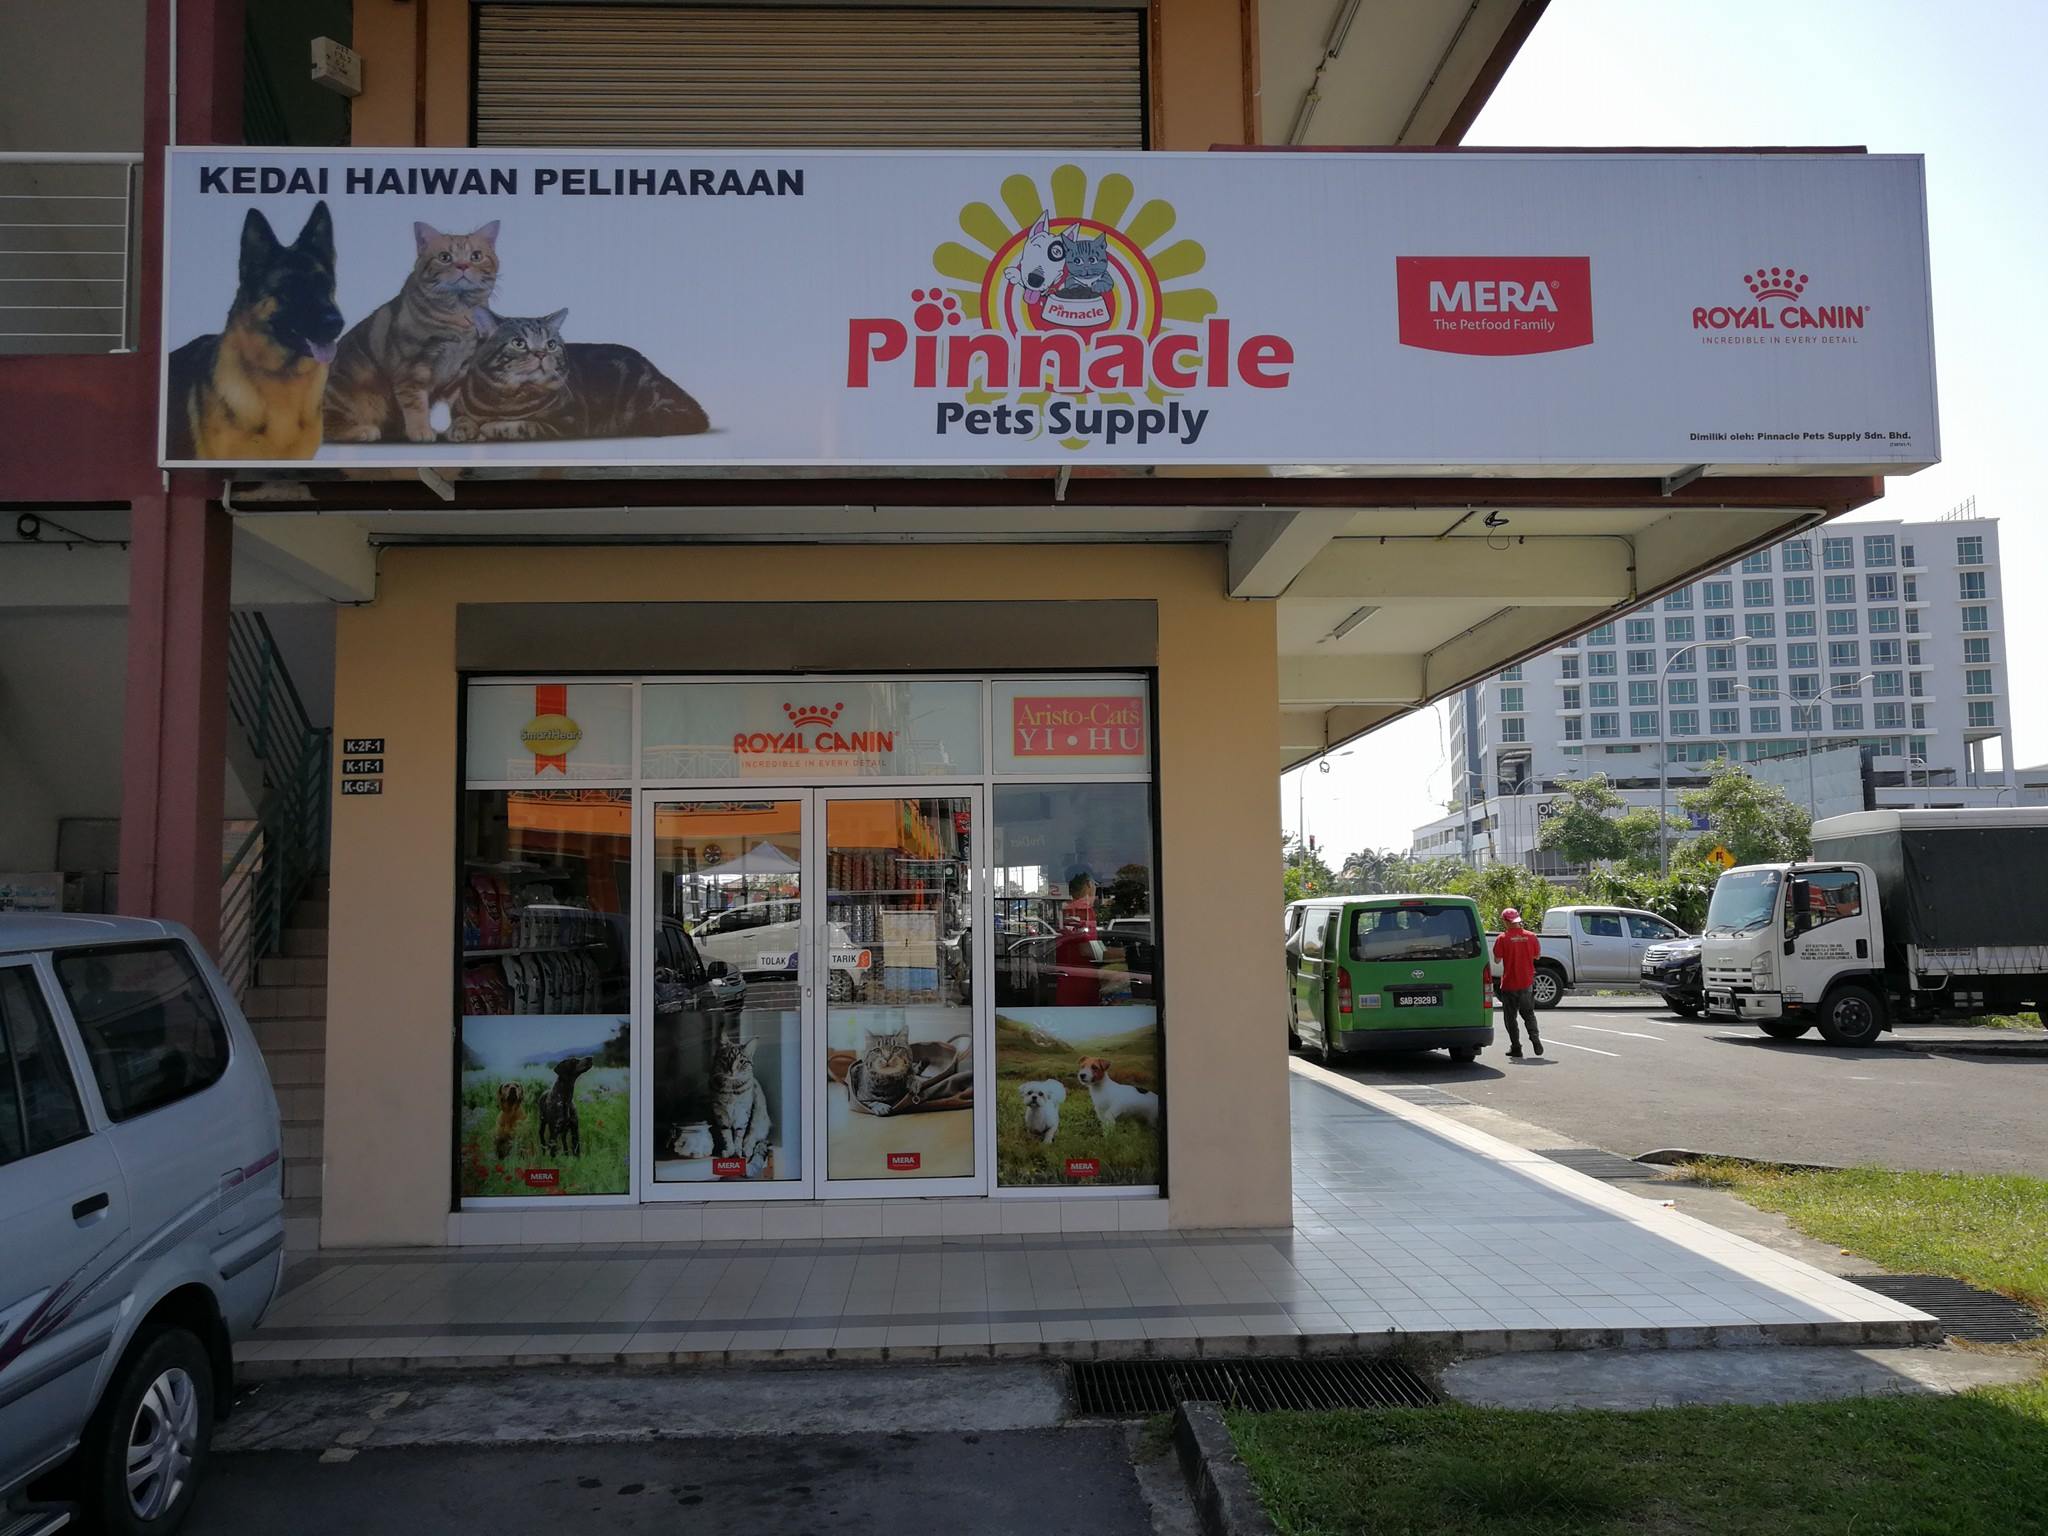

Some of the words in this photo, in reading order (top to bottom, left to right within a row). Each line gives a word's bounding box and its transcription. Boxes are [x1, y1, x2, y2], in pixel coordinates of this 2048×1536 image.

[200, 166, 329, 195] KEDAI
[346, 168, 518, 196] HAIWAN
[534, 169, 805, 197] PELIHARAAN
[1048, 304, 1104, 319] Pinnacle
[1692, 306, 1775, 329] ROYAL
[1780, 306, 1864, 329] CANIN
[1433, 319, 1457, 330] The
[1460, 319, 1511, 330] Petfood
[1514, 319, 1555, 333] Family
[1702, 336, 1766, 345] INCREDIBLE
[1770, 336, 1781, 344] IN
[1785, 336, 1818, 344] EVERY
[1821, 336, 1859, 344] DETAIL
[846, 318, 1295, 388] Pinnacle
[936, 402, 1034, 434] Pets
[1048, 401, 1209, 444] Supply
[1689, 432, 1727, 441] Dimiliki
[1729, 433, 1755, 441] oleh:
[1757, 432, 1800, 441] Pinnacle
[1802, 432, 1825, 440] Pets
[1827, 431, 1862, 442] Supply
[1864, 431, 1886, 440] Sdn.
[1888, 431, 1911, 440] Bhd.
[1018, 702, 1140, 726] Aristo-Cats
[520, 728, 584, 742] SmartHeart
[346, 740, 381, 752] K-2F-1
[734, 732, 811, 754] ROYAL
[815, 731, 894, 753] CANIN
[345, 760, 381, 772] K-1F-1
[741, 760, 801, 769] INCREDIBLE
[804, 760, 816, 768] IN
[818, 760, 849, 768] EVERY
[852, 759, 887, 767] DETAIL
[343, 781, 380, 793] K-GF-1
[760, 956, 786, 966] TOLAK
[832, 955, 857, 963] TARIK
[1399, 996, 1413, 1005] SAB
[1071, 1162, 1094, 1170] MERA
